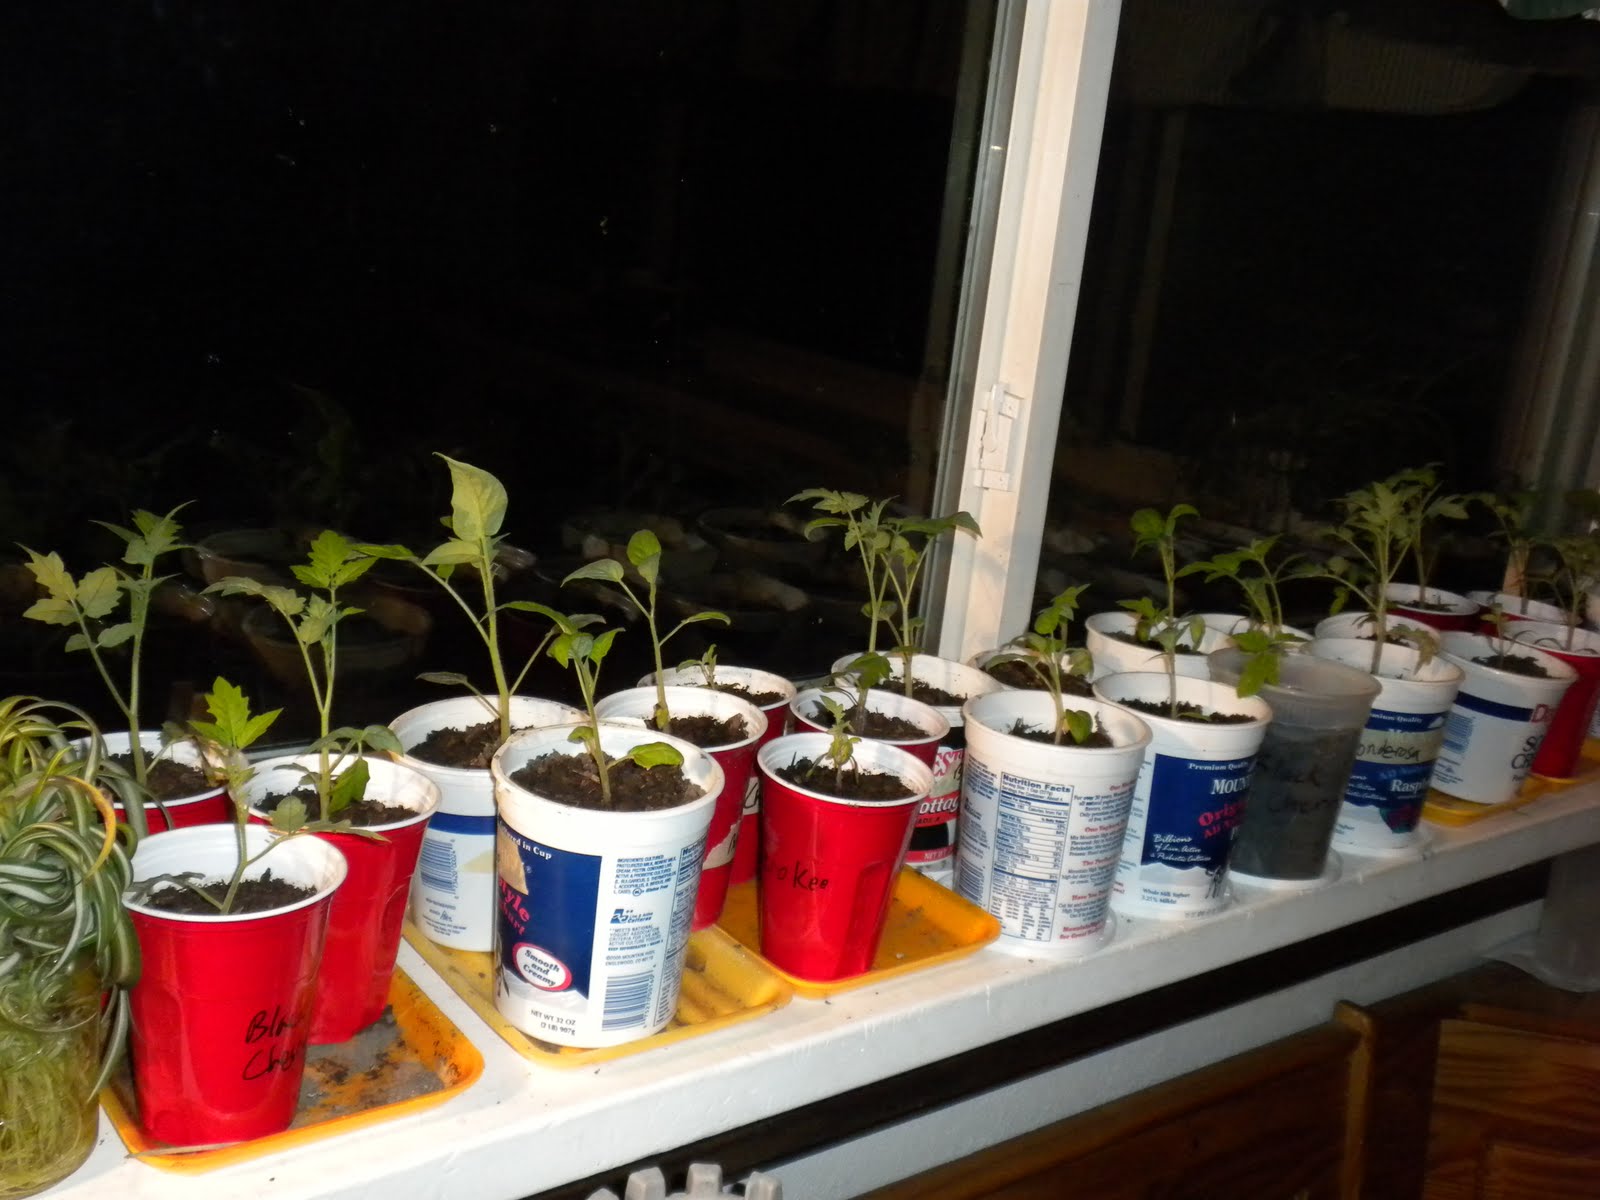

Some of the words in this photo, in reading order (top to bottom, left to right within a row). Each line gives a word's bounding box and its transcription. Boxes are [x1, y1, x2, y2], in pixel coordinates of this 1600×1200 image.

[1357, 738, 1420, 761] onderosa
[1189, 762, 1227, 771] Premium
[1003, 774, 1041, 790] Nutrition
[1044, 784, 1071, 793] Facts
[1153, 833, 1193, 843] Billions
[522, 841, 532, 852] in
[533, 846, 553, 860] Cup
[776, 859, 829, 891] oKee
[524, 949, 560, 972] Smooth
[531, 963, 550, 976] and
[523, 963, 557, 987] Creamy
[530, 1009, 542, 1018] NET
[543, 1013, 554, 1022] WT
[556, 1016, 564, 1024] 32
[565, 1018, 576, 1026] OZ
